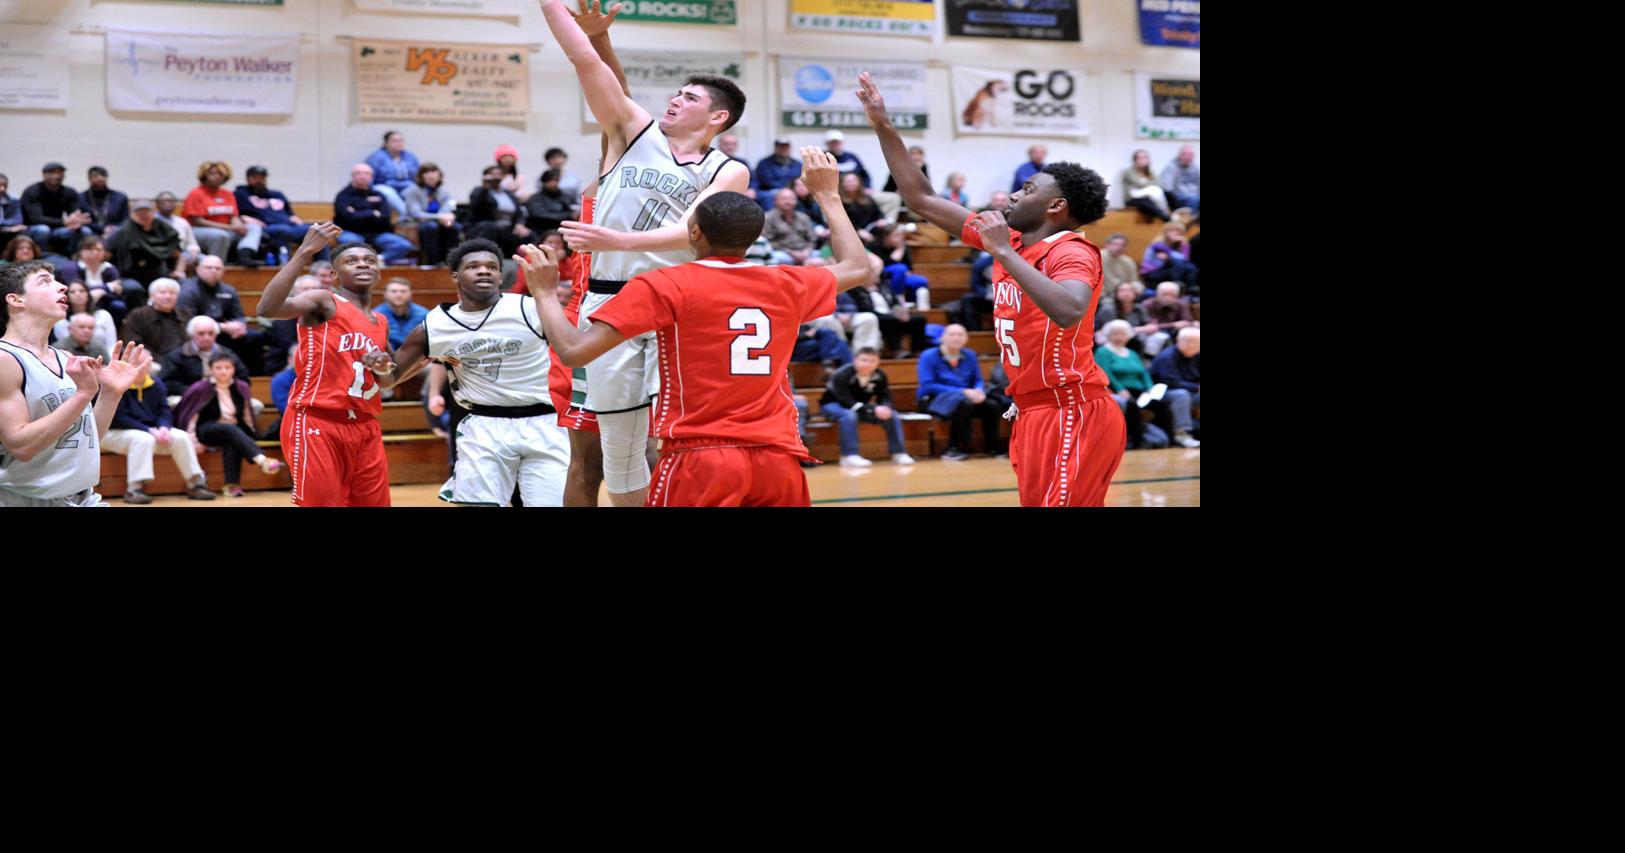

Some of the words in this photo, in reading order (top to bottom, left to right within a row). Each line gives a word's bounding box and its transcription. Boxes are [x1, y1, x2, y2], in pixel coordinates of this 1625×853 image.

[638, 1, 707, 17] ROCKS!
[164, 55, 228, 74] Peyton
[233, 57, 292, 73] Walker
[1015, 69, 1075, 101] GO
[791, 111, 816, 126] GO
[1013, 102, 1076, 118] ROCKS
[620, 166, 699, 210] ROCK
[632, 198, 671, 231] 11
[727, 306, 771, 376] 2
